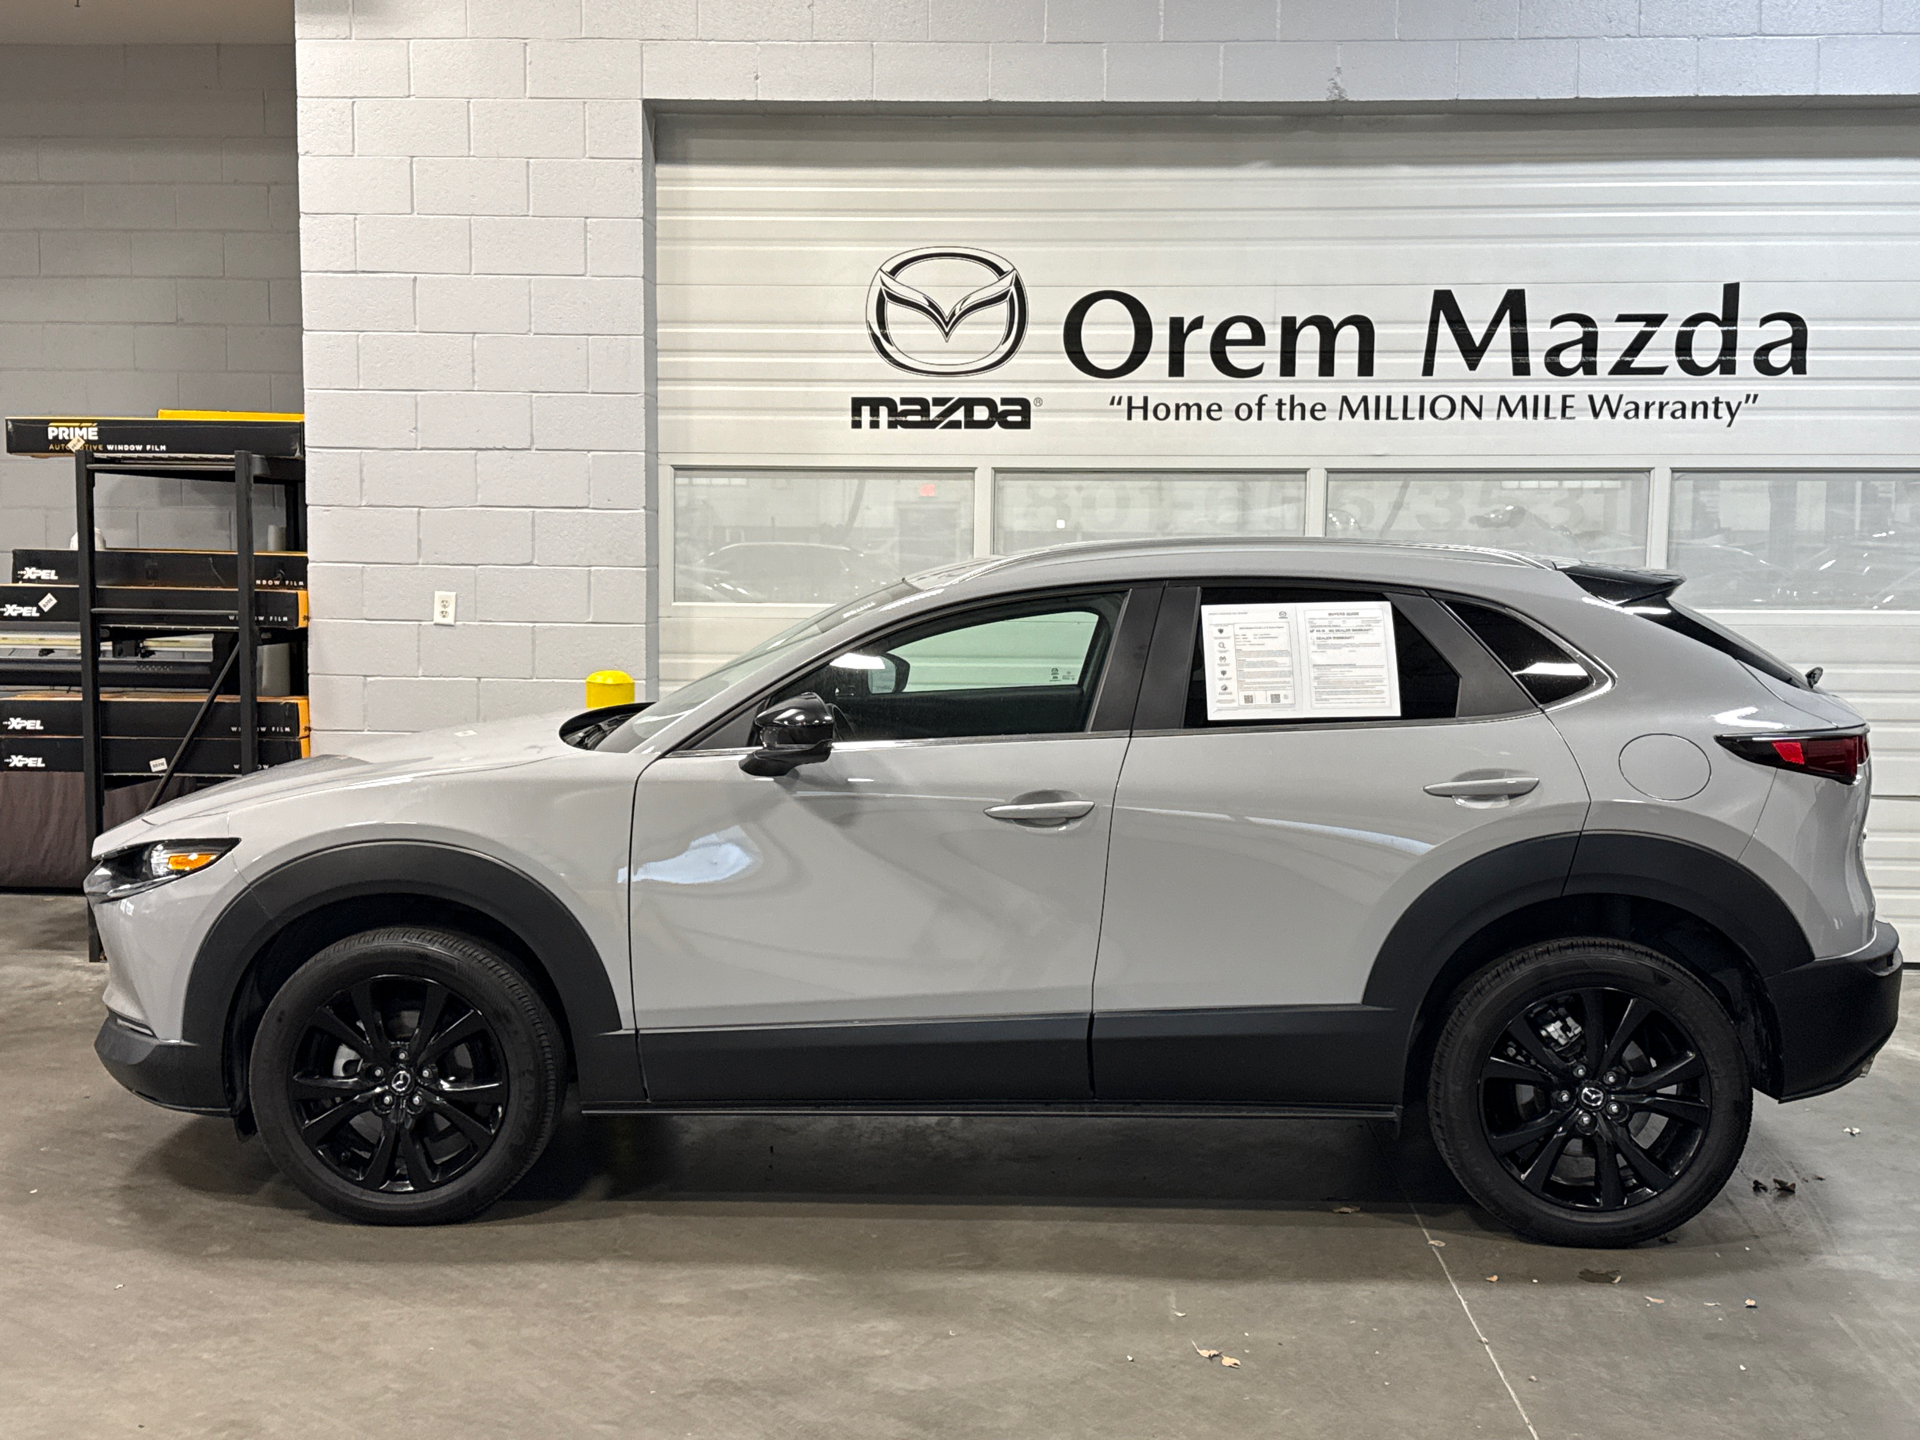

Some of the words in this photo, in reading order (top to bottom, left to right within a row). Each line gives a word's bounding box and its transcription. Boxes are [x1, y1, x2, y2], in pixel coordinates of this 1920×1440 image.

[1063, 290, 1375, 379] Orem
[1421, 282, 1808, 377] Mazda
[1234, 393, 1268, 422] of
[1276, 394, 1327, 421] the
[1338, 394, 1483, 421] MILLION
[1496, 394, 1575, 420] MILE
[47, 426, 99, 440] PRIME
[22, 567, 59, 580] XPEL
[3, 604, 41, 617] XPEL
[7, 717, 44, 730] XPEL
[8, 755, 46, 767] XPEL
